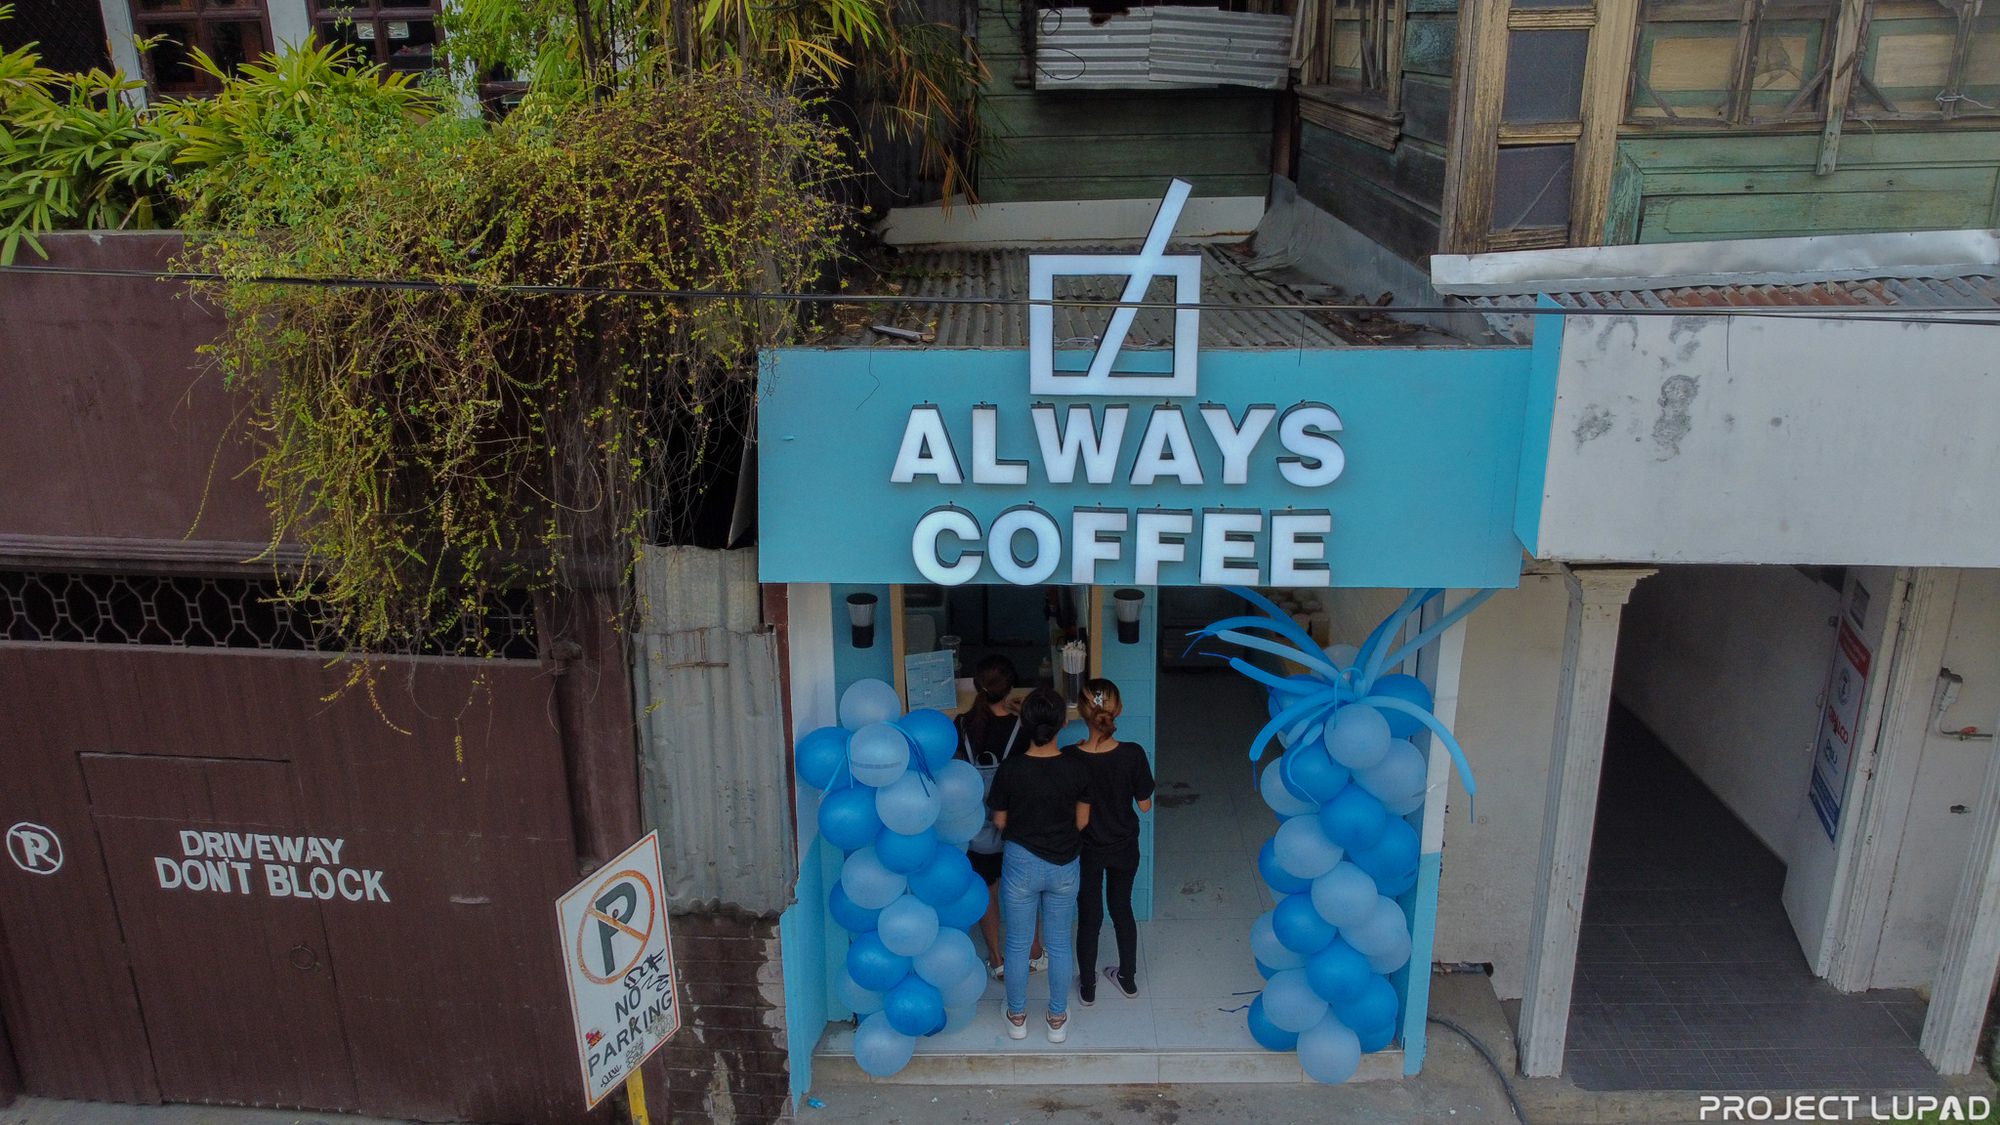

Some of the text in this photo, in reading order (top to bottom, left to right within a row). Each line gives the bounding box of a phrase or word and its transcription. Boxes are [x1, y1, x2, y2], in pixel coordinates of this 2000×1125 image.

[889, 402, 1346, 488] ALWAYS
[912, 504, 1331, 586] COFFEE
[154, 856, 391, 902] DON'T BLOCK
[179, 830, 344, 865] DRIVEWAY
[587, 990, 673, 1077] PARKING
[614, 985, 642, 1023] NO
